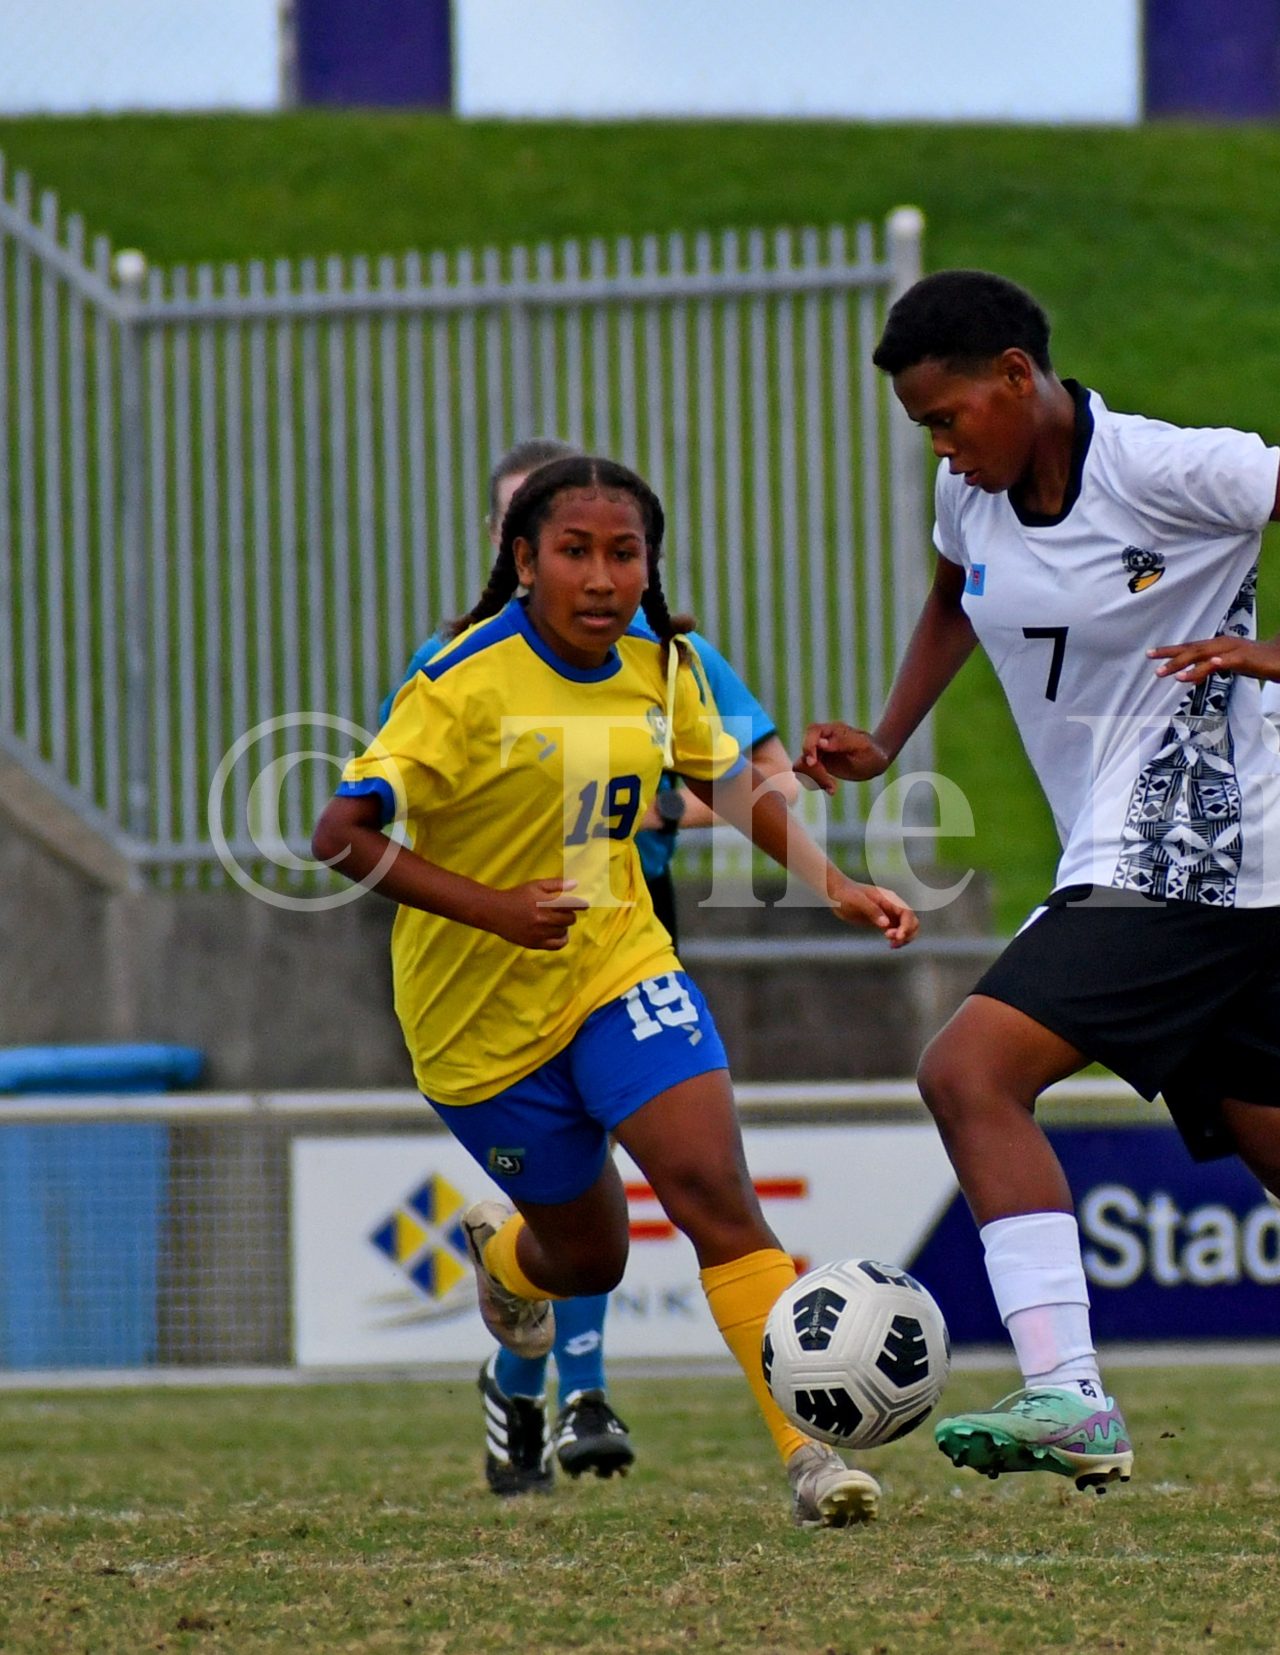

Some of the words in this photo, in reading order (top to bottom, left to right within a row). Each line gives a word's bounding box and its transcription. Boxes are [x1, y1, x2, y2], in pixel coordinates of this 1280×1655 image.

[1021, 625, 1070, 703] 7
[564, 773, 642, 847] 19
[620, 970, 700, 1042] 19
